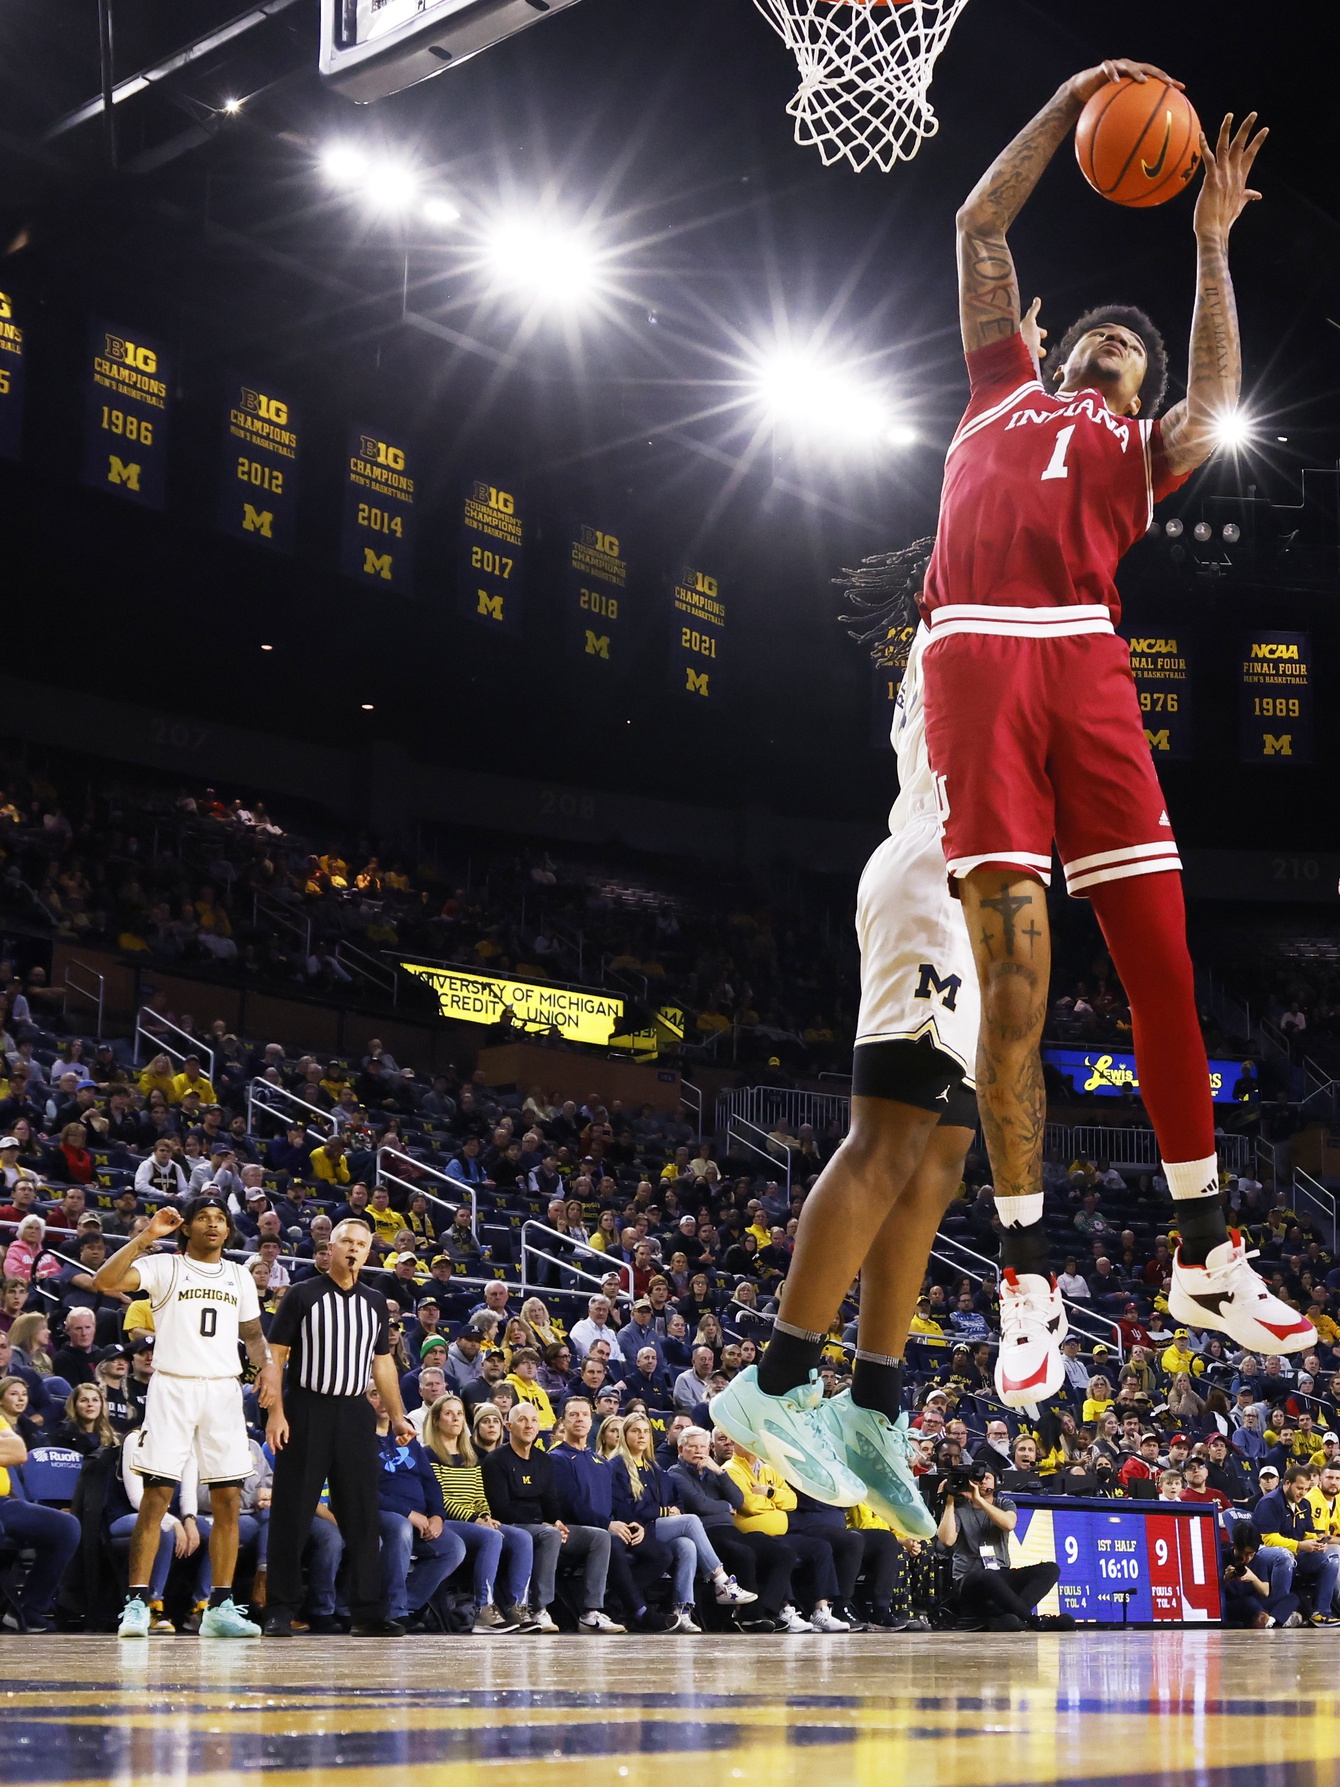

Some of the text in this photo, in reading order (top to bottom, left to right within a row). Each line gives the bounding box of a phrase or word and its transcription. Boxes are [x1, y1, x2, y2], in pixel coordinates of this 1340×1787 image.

[94, 357, 166, 397] CHAMPIONS
[101, 406, 153, 446] 1986
[230, 409, 296, 447] CHAMPIONS
[1004, 398, 1130, 453] INDIANA
[1040, 424, 1076, 481] 1
[107, 455, 141, 492] M
[237, 457, 283, 494] 2012
[350, 458, 414, 492] CHAMPIONS
[242, 503, 273, 538] M
[358, 503, 403, 538] 2014
[465, 506, 522, 536] CHAMPIONS
[363, 547, 393, 580] M
[471, 546, 513, 579] 2017
[477, 589, 504, 621] M
[579, 588, 618, 619] 2018
[674, 586, 725, 617] CHAMPIONS
[585, 629, 610, 660] M
[681, 627, 716, 658] 2021
[1129, 638, 1177, 654] NCAA
[1251, 643, 1299, 660] NCAA
[1129, 658, 1186, 669] INAL FOUR
[1143, 671, 1187, 679] BASKETBALL
[1243, 662, 1308, 675] FINAL FOUR
[686, 667, 709, 697] M
[1266, 676, 1308, 685] BASKETBALL
[1140, 692, 1179, 712] 976
[1254, 698, 1300, 718] 1989
[1263, 733, 1292, 755] M
[513, 987, 534, 1002] OF
[539, 993, 620, 1017] MICHIGAN
[914, 963, 962, 1012] M
[439, 992, 579, 1028] CREDIT UNION
[178, 1288, 238, 1306] MICHIGAN
[199, 1308, 217, 1338] 0
[50, 1450, 82, 1462] Ruoff
[1314, 1507, 1322, 1519] 9
[1064, 1535, 1078, 1565] 9
[1097, 1539, 1137, 1552] 1ST HALF
[1155, 1538, 1168, 1566] 9
[1099, 1558, 1139, 1579] 16:10
[1059, 1586, 1090, 1596] FOULS 1
[1064, 1597, 1087, 1608] TOL 4
[1113, 1593, 1130, 1603] POS
[1152, 1586, 1180, 1596] FOULS 1
[1156, 1598, 1176, 1608] TOL 4
